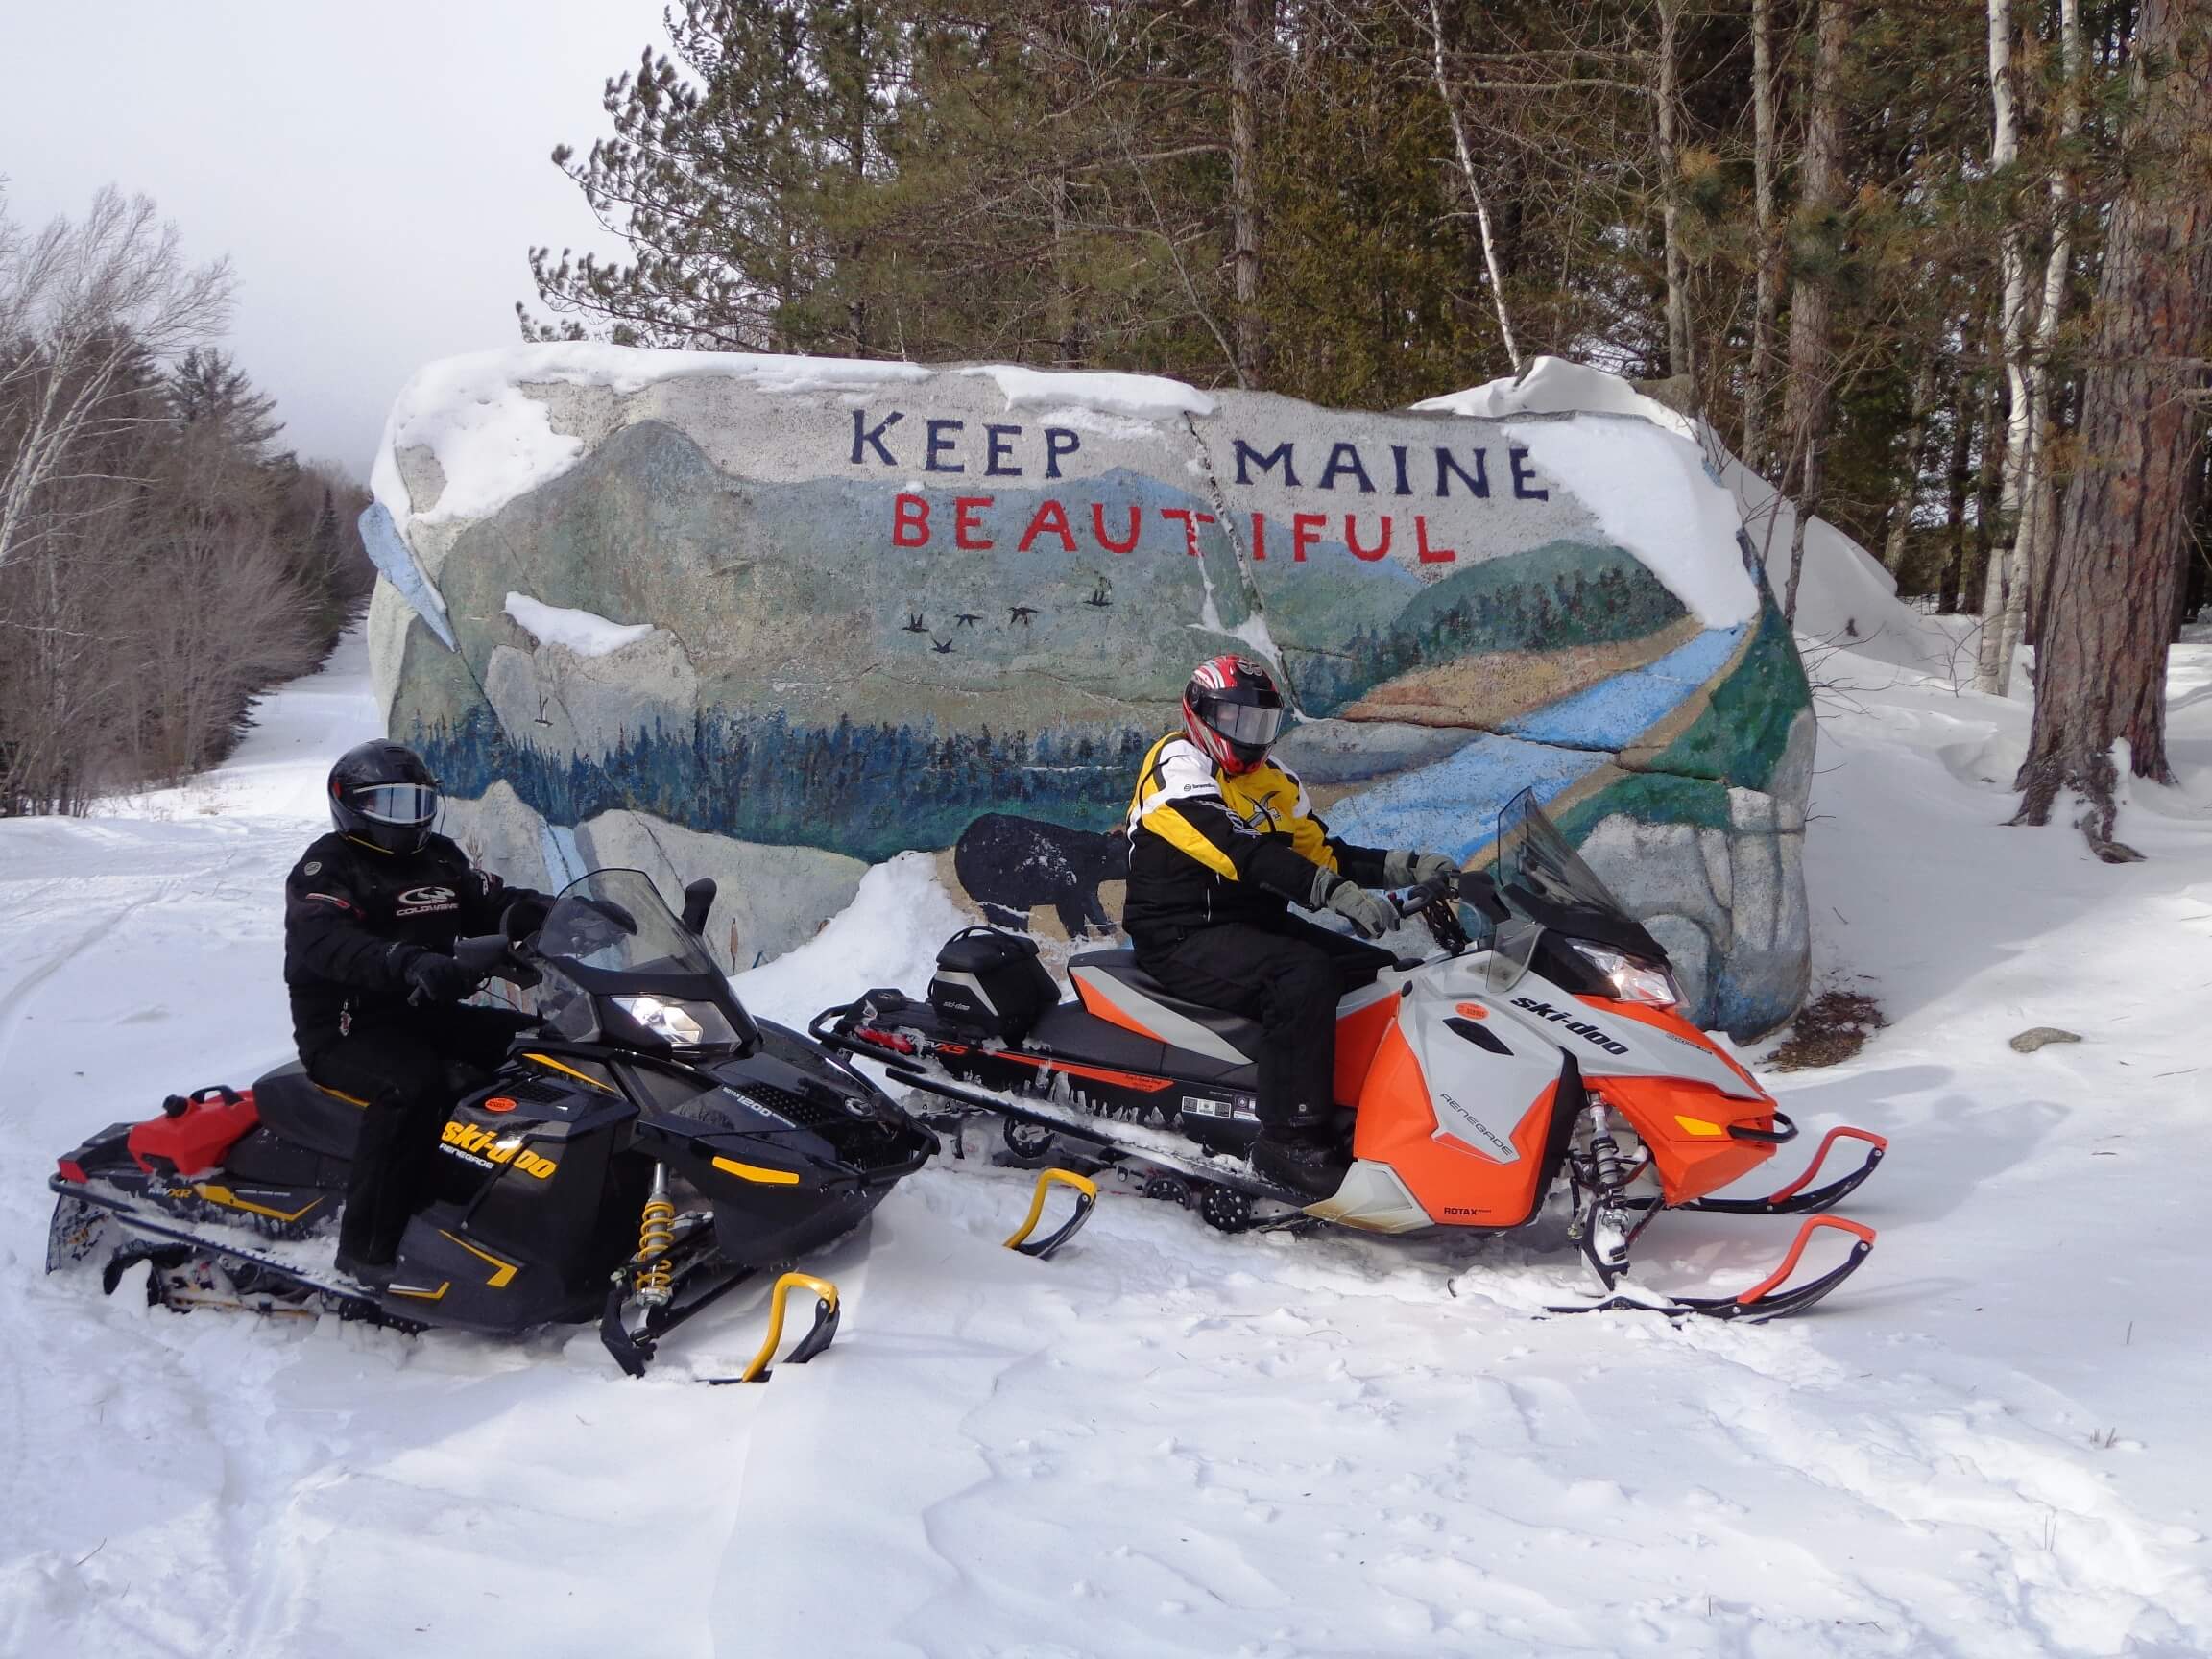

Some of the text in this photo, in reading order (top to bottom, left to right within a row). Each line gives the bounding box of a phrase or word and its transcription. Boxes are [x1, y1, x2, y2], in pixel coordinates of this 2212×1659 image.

[851, 409, 1549, 502] KEEP MAINE
[893, 493, 1456, 565] BEAUTIFUL
[1509, 997, 1629, 1056] ski-doo
[737, 1095, 773, 1118] 1200
[1440, 1093, 1513, 1156] RENEGADE
[441, 1120, 558, 1179] ski-doo
[1443, 1207, 1479, 1215] ROTAX
